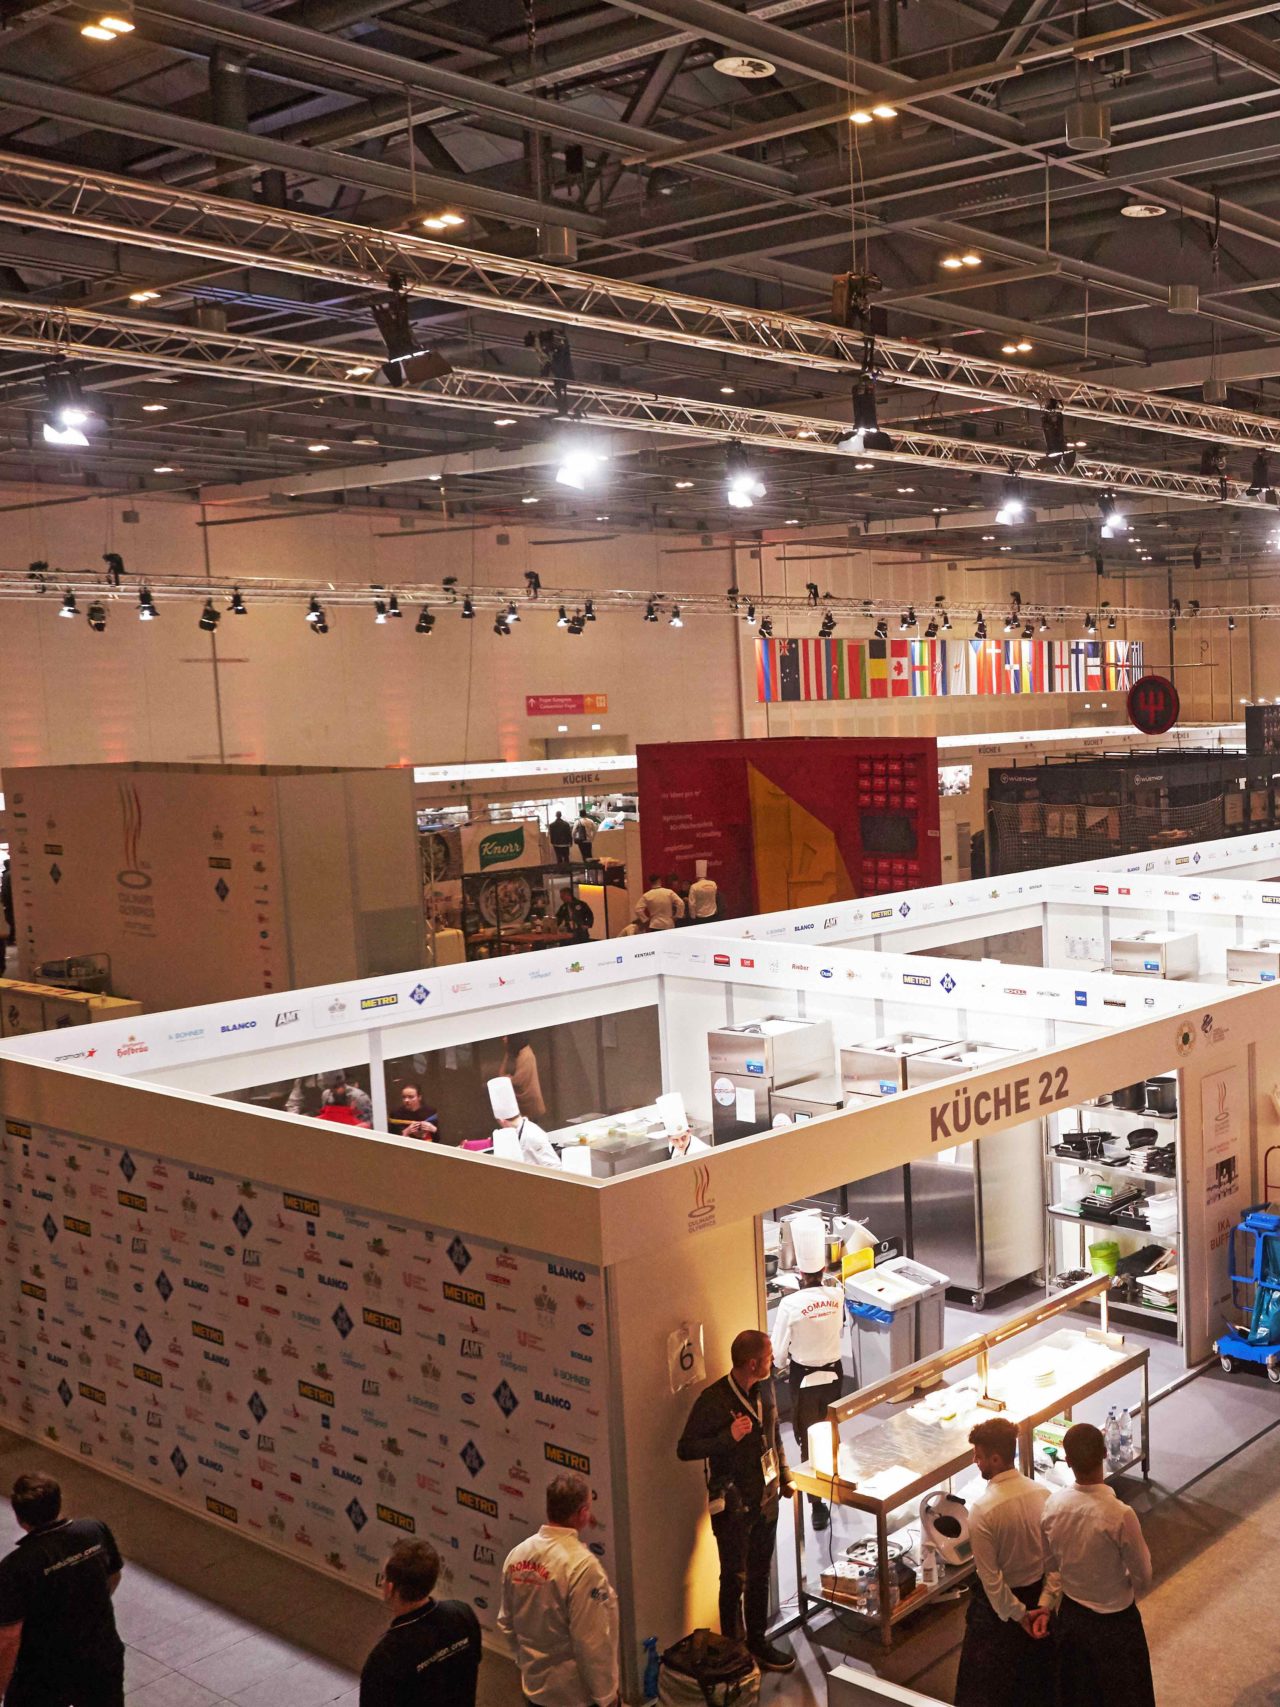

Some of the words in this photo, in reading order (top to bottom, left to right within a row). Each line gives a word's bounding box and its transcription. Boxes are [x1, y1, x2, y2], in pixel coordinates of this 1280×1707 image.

[563, 773, 593, 784] KÜCHE
[594, 773, 600, 782] 4
[481, 838, 522, 857] Knorr
[872, 909, 893, 919] METRO
[794, 923, 815, 932] BLANCO
[903, 975, 931, 986] METRO
[362, 995, 398, 1009] METRO
[220, 1020, 257, 1033] BLANCO
[930, 1076, 1031, 1142] KÜCHE
[1038, 1065, 1069, 1106] 22
[285, 1194, 319, 1214] METRO
[1218, 1217, 1231, 1233] IKA
[1210, 1231, 1230, 1251] BUFF
[318, 1274, 349, 1291] BLANCO
[548, 1263, 586, 1283] BLANCO
[443, 1283, 485, 1308] METRO
[801, 1300, 839, 1316] ROMANIA
[363, 1309, 401, 1333] METRO
[193, 1322, 223, 1344] METRO
[300, 1382, 334, 1406] METRO
[534, 1390, 571, 1411] BLANCO
[545, 1445, 590, 1473] METRO
[332, 1466, 363, 1486] BLANCO
[458, 1489, 498, 1516] METRO
[377, 1505, 414, 1532] METRO
[509, 1560, 549, 1580] ROMANIA
